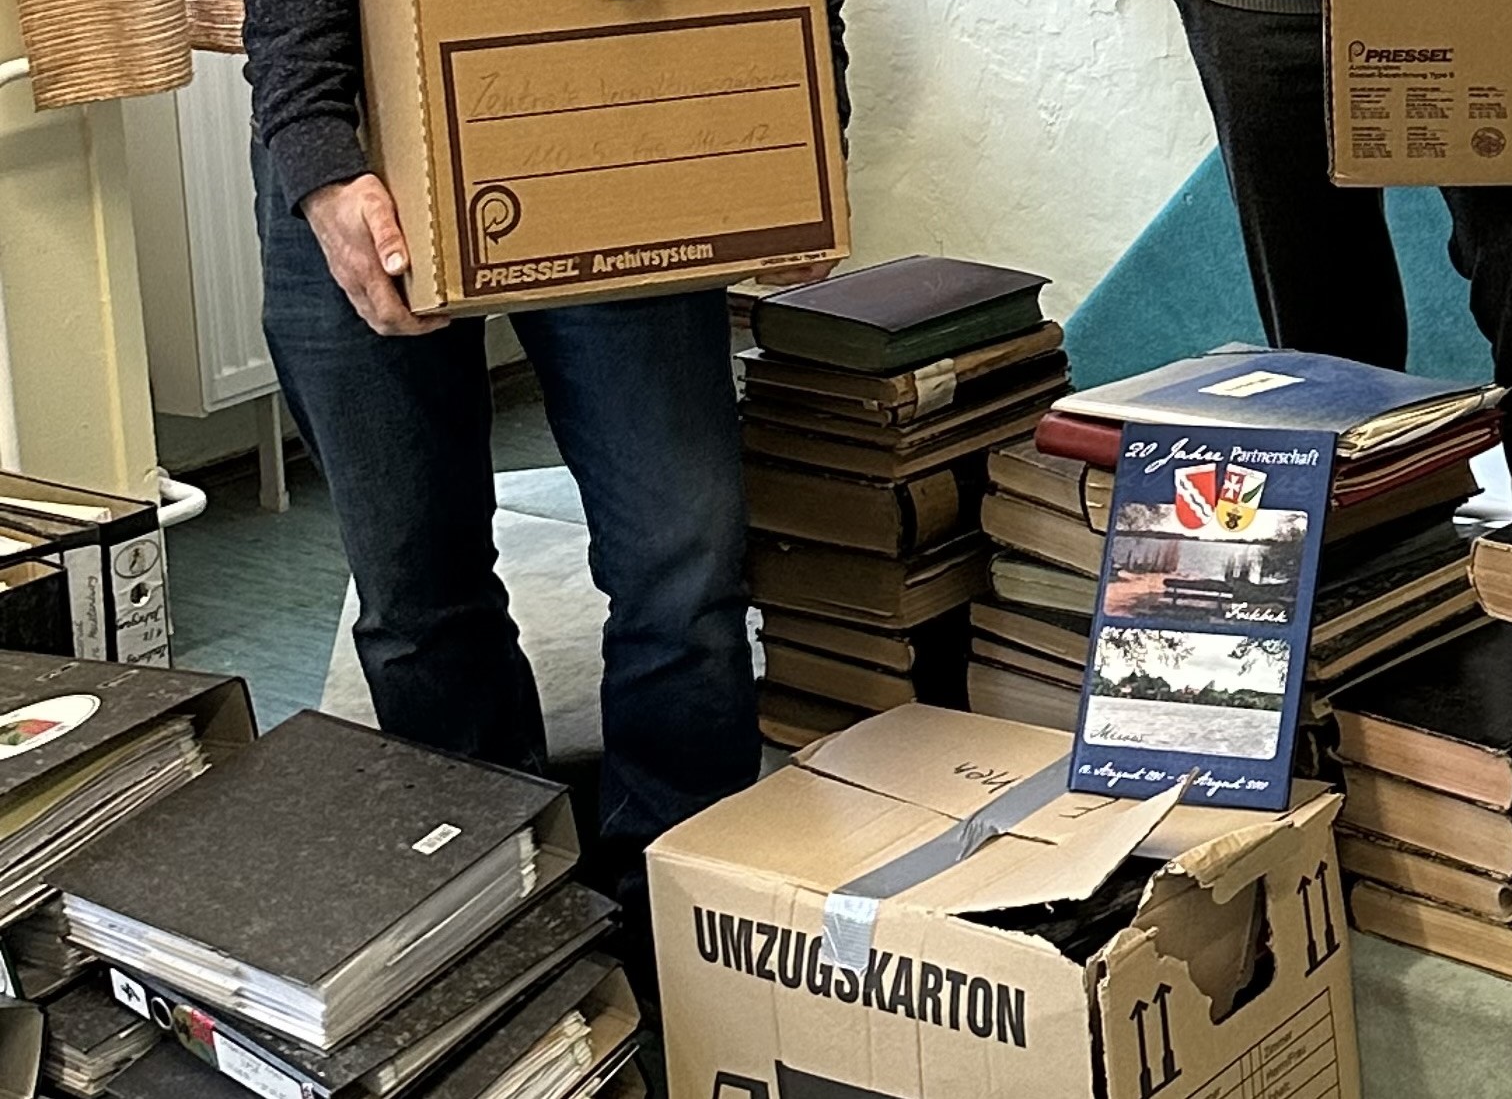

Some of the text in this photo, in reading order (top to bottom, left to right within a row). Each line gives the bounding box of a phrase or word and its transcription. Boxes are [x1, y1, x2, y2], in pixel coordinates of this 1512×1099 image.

[1364, 48, 1455, 63] PRESSEL
[474, 242, 715, 289] PRESSEL Archivsystem
[1124, 437, 1320, 474] 20 Jahre Partnerschaft
[693, 904, 1027, 1049] UMZUGSKARTON
